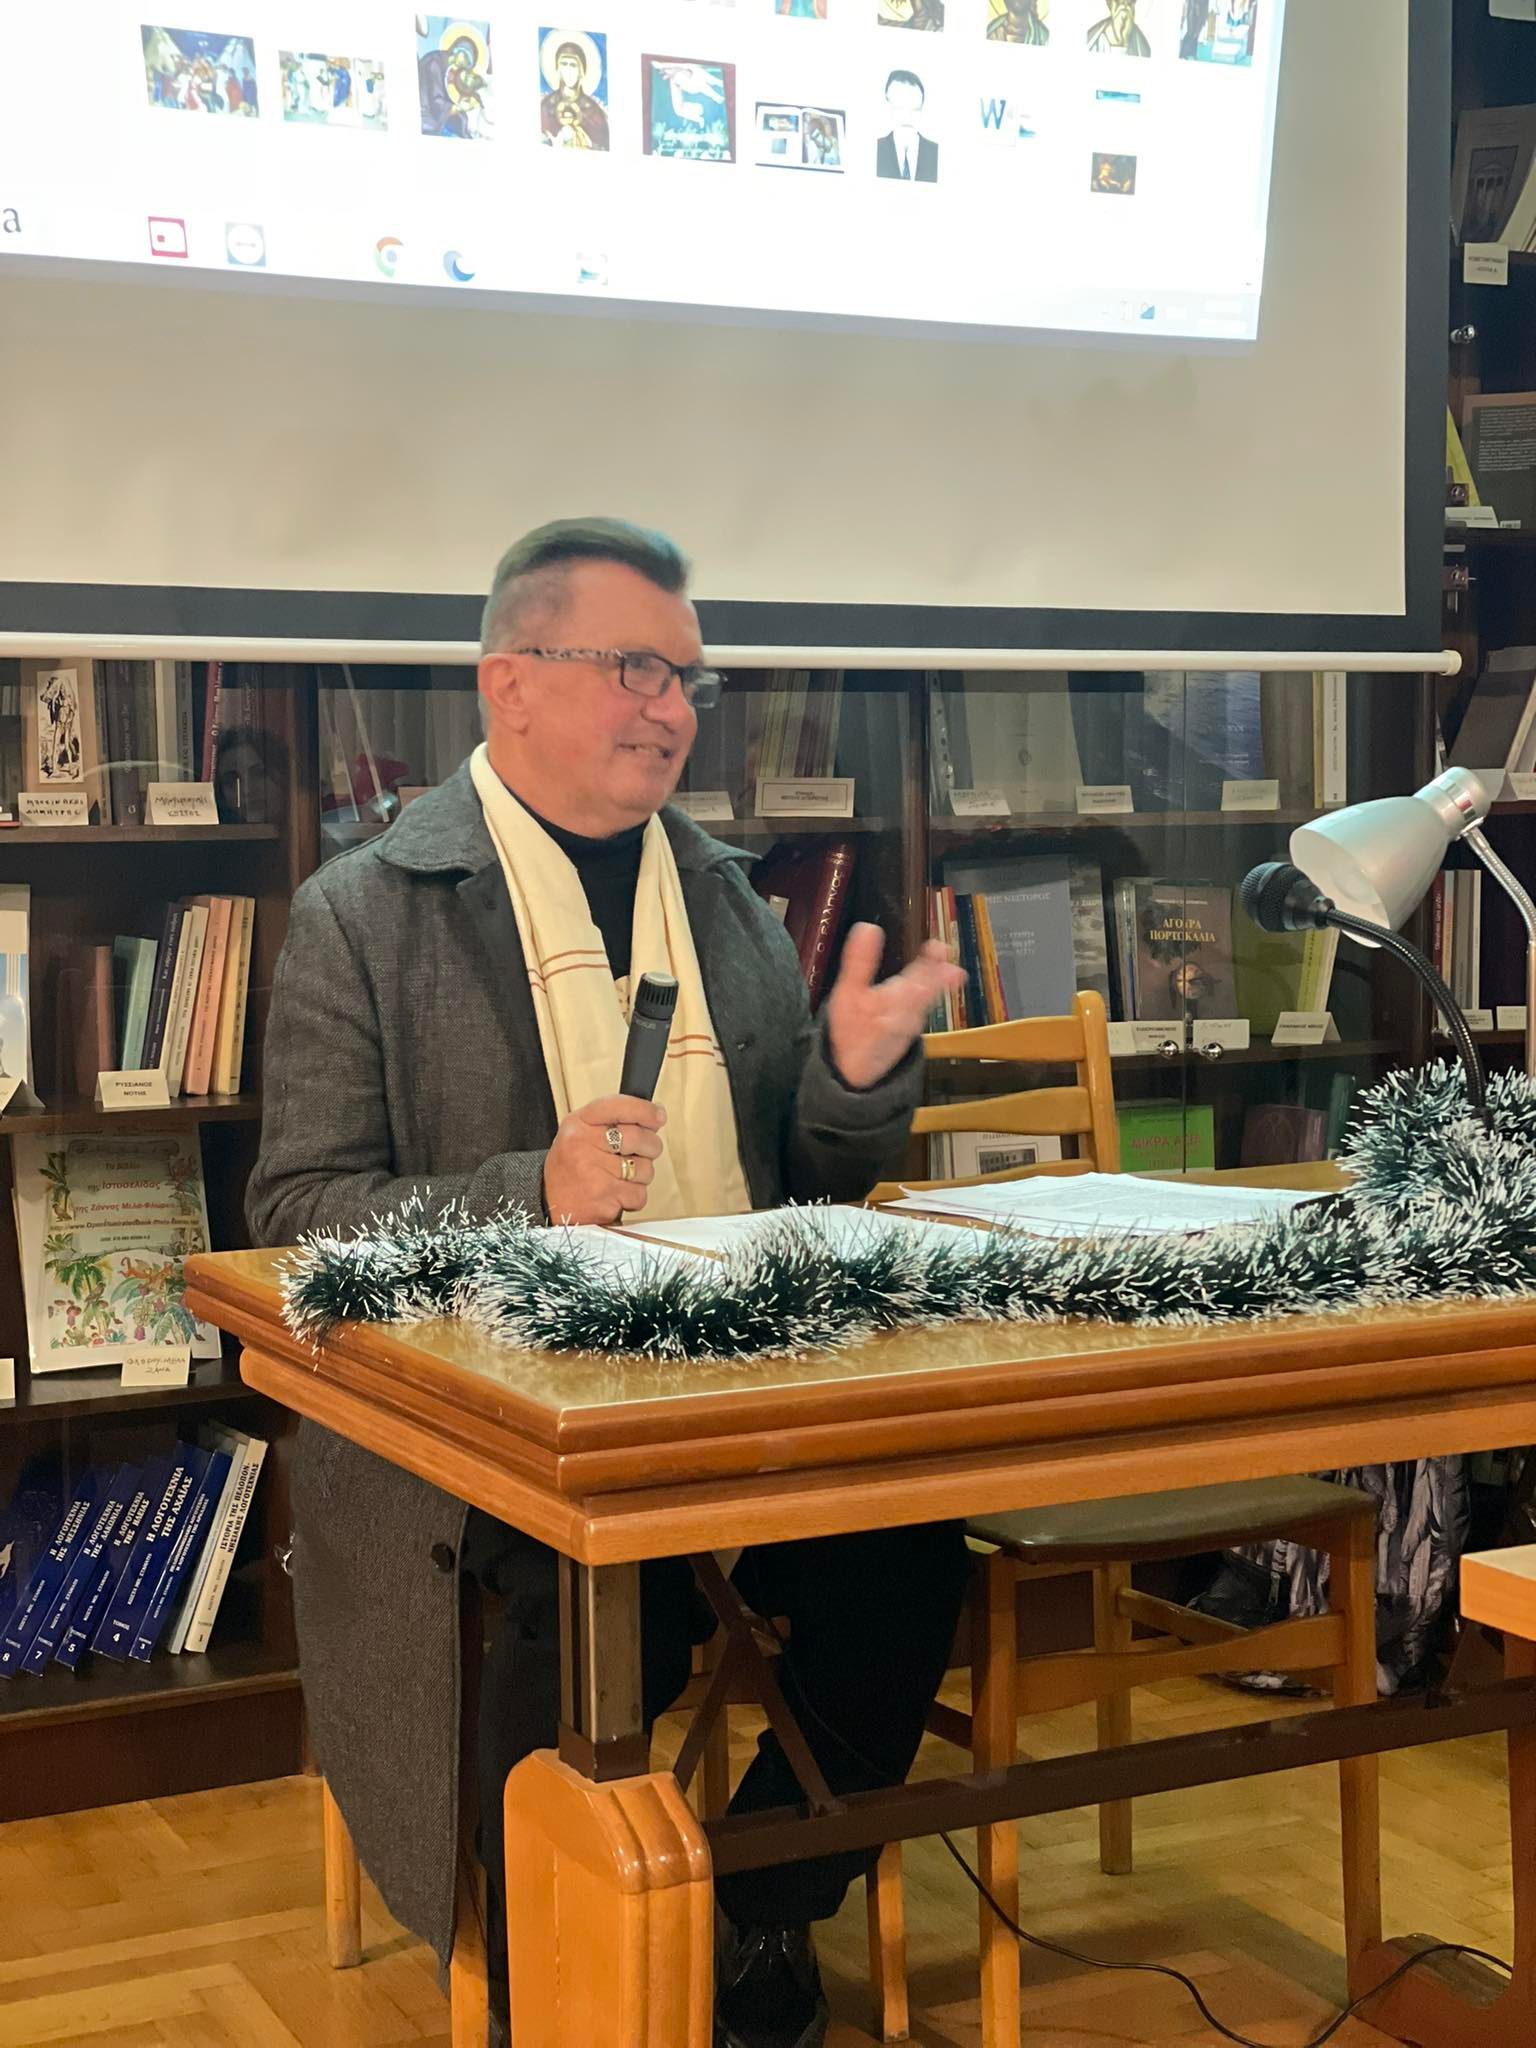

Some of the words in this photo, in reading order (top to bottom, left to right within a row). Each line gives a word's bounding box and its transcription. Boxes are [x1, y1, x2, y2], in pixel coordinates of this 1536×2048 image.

[1150, 930, 1216, 942] ΠΟΡΤΟΚΑΛΙΑ
[55, 1500, 82, 1546] ΛΟΓΟΤΕΧΝΙΑ
[88, 1500, 116, 1545] ΛΟΓΟΤΕΧΝΙΑ
[118, 1491, 144, 1537] ΛΟΓΟΤΕΧΝΙΑ
[123, 1530, 135, 1545] ΤΗΣ
[133, 1499, 150, 1528] ΗΛΕΙΑΣ
[146, 1532, 156, 1543] Η
[151, 1466, 184, 1530] ΛΟΓΟΤΕΧΝΙΑ
[161, 1514, 176, 1538] ΤΗΣ
[220, 1520, 234, 1550] ΙΣΤΟΡΙΑ
[230, 1502, 238, 1518] ΤΗΣ
[228, 1515, 244, 1554] ΝΗΣΙΑΚΗΣ
[240, 1462, 260, 1514] ΛΟΓΟΤΕΧΝΙΑΣ
[56, 1547, 68, 1562] ΤΗΣ
[65, 1501, 90, 1544] ΜΕΣΣΗΝΙΑΣ
[90, 1544, 102, 1559] ΤΗΣ
[100, 1503, 124, 1542] ΛΑΚΩΝΙΑΣ
[2, 1652, 10, 1662] 8
[34, 1650, 42, 1660] 7
[68, 1642, 76, 1652] 5
[112, 1632, 120, 1642] 4
